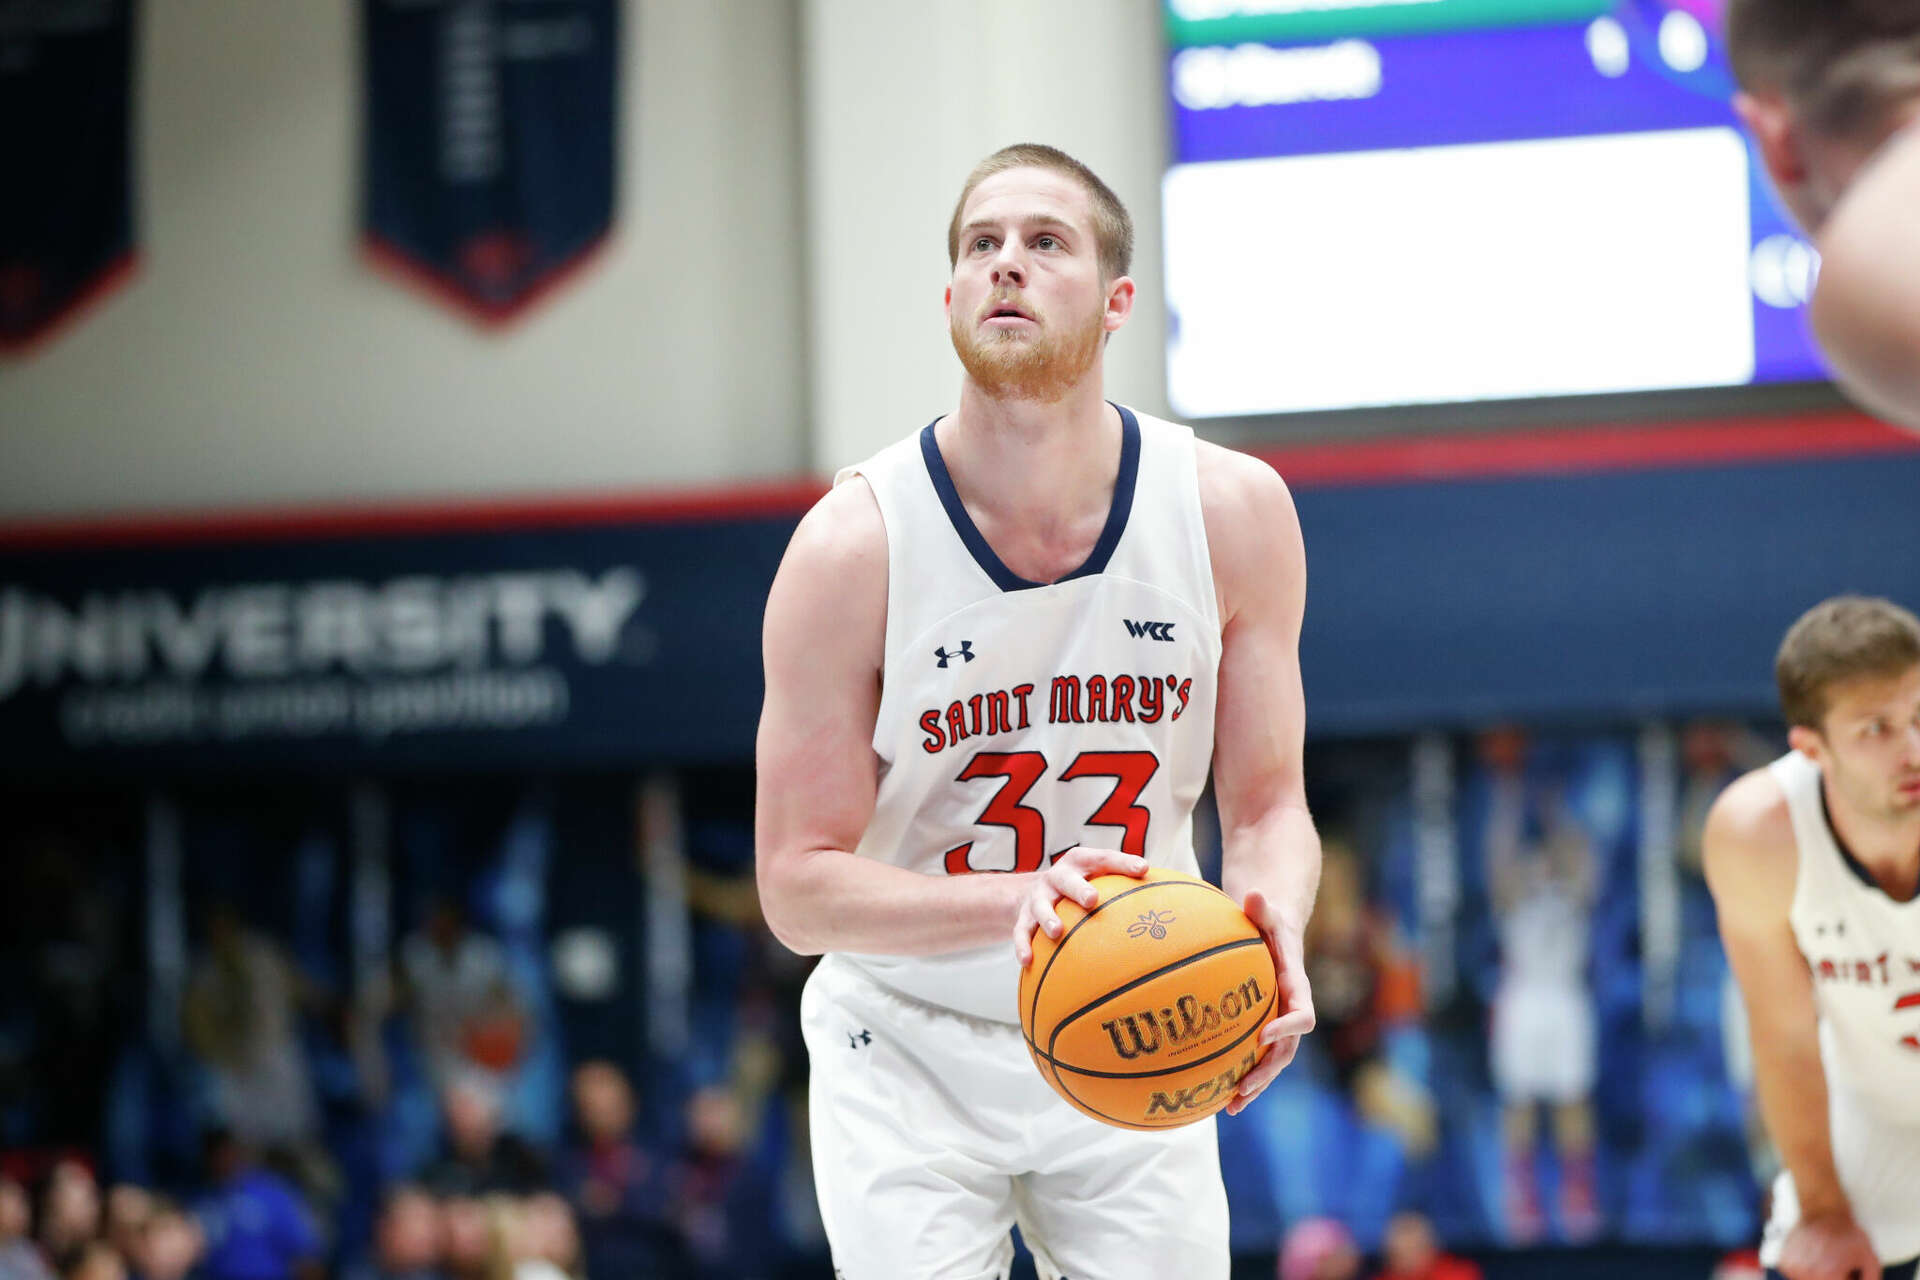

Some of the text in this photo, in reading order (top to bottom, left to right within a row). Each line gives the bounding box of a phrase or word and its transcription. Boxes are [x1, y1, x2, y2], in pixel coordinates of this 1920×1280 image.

[1122, 618, 1177, 642] WCC
[919, 674, 1193, 754] SAINT MARY'S
[944, 749, 1160, 875] 33
[1101, 975, 1264, 1060] Wilson
